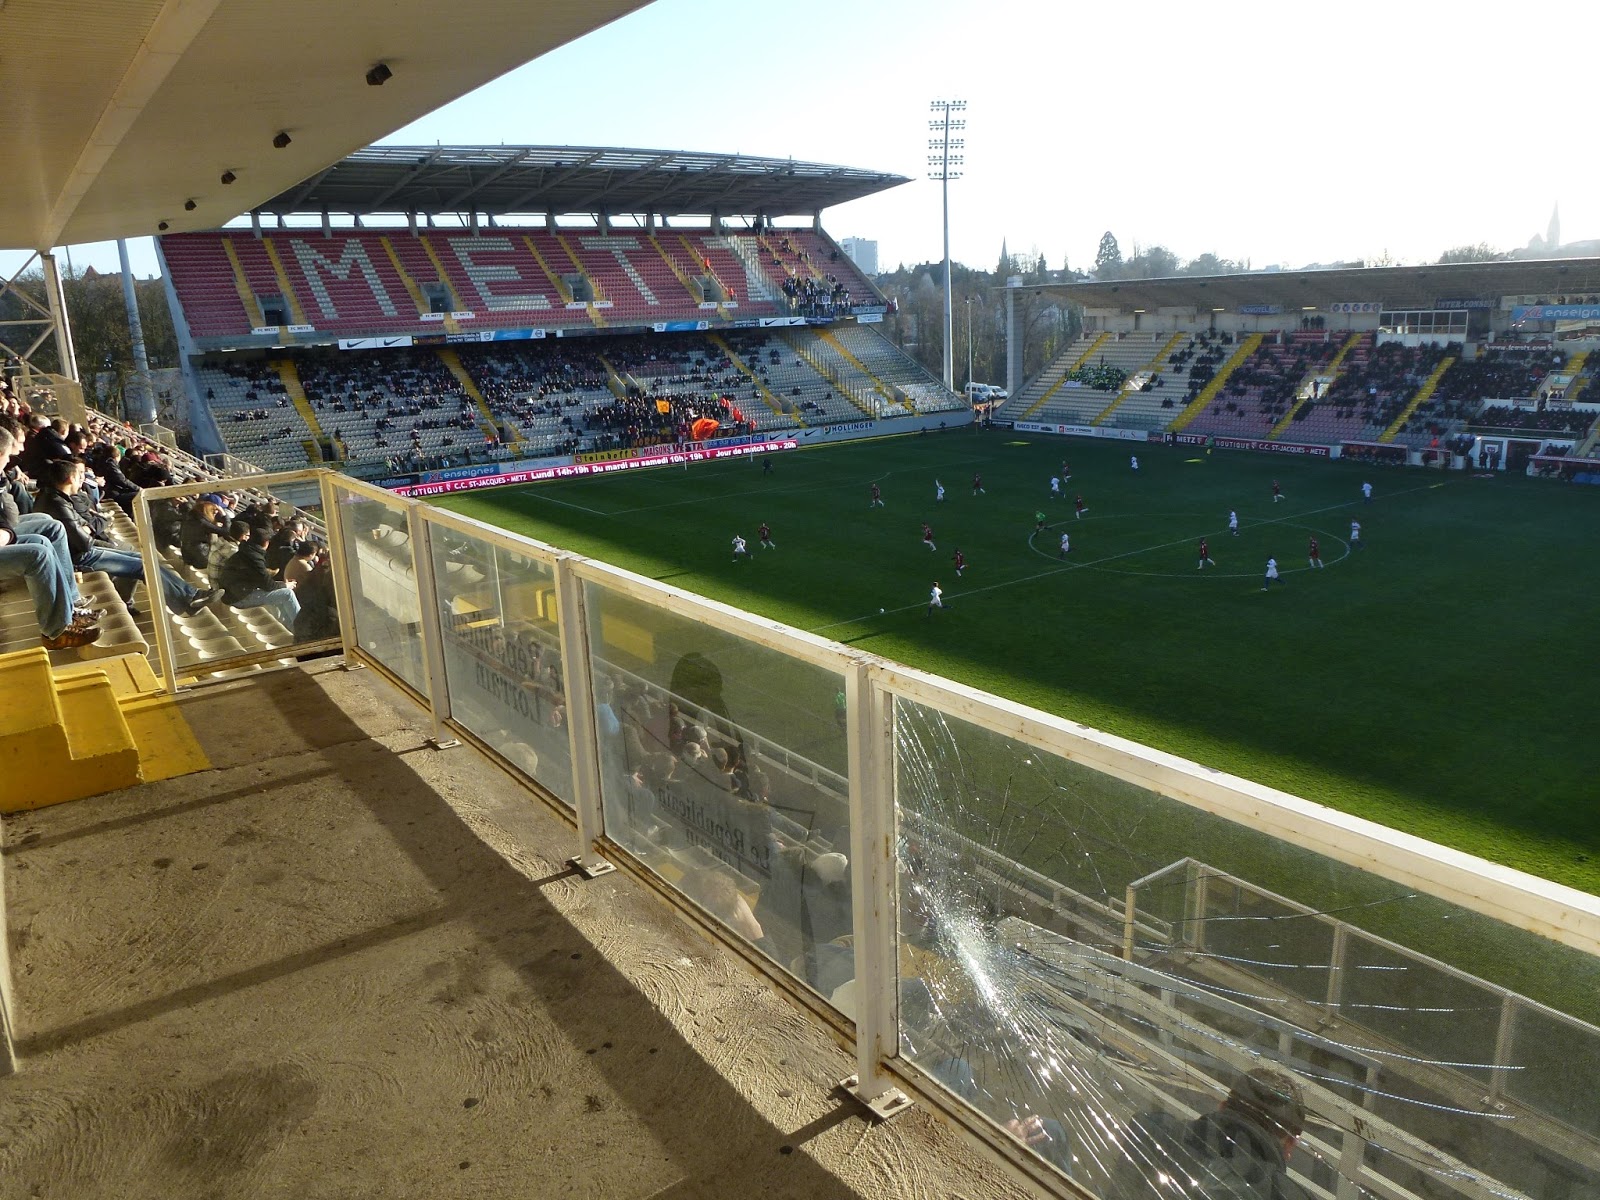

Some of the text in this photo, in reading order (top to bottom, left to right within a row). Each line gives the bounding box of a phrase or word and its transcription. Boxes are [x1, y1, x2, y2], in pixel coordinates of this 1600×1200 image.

[1520, 306, 1542, 320] XL
[832, 422, 873, 432] HOLLINGER
[643, 444, 670, 457] MAISONS
[716, 449, 731, 458] Jour
[1216, 440, 1249, 450] BOUTIQUE
[1271, 444, 1305, 454] ST-JACQUES
[428, 467, 494, 483] XL enseignes
[470, 477, 506, 488] ST-JACQUES
[531, 468, 555, 479] Lundi
[557, 466, 589, 476] 14h-19h
[592, 465, 604, 473] Du
[605, 461, 628, 471] mardi
[641, 455, 668, 466] samedi
[670, 454, 684, 463] 10h
[690, 452, 703, 461] 19h
